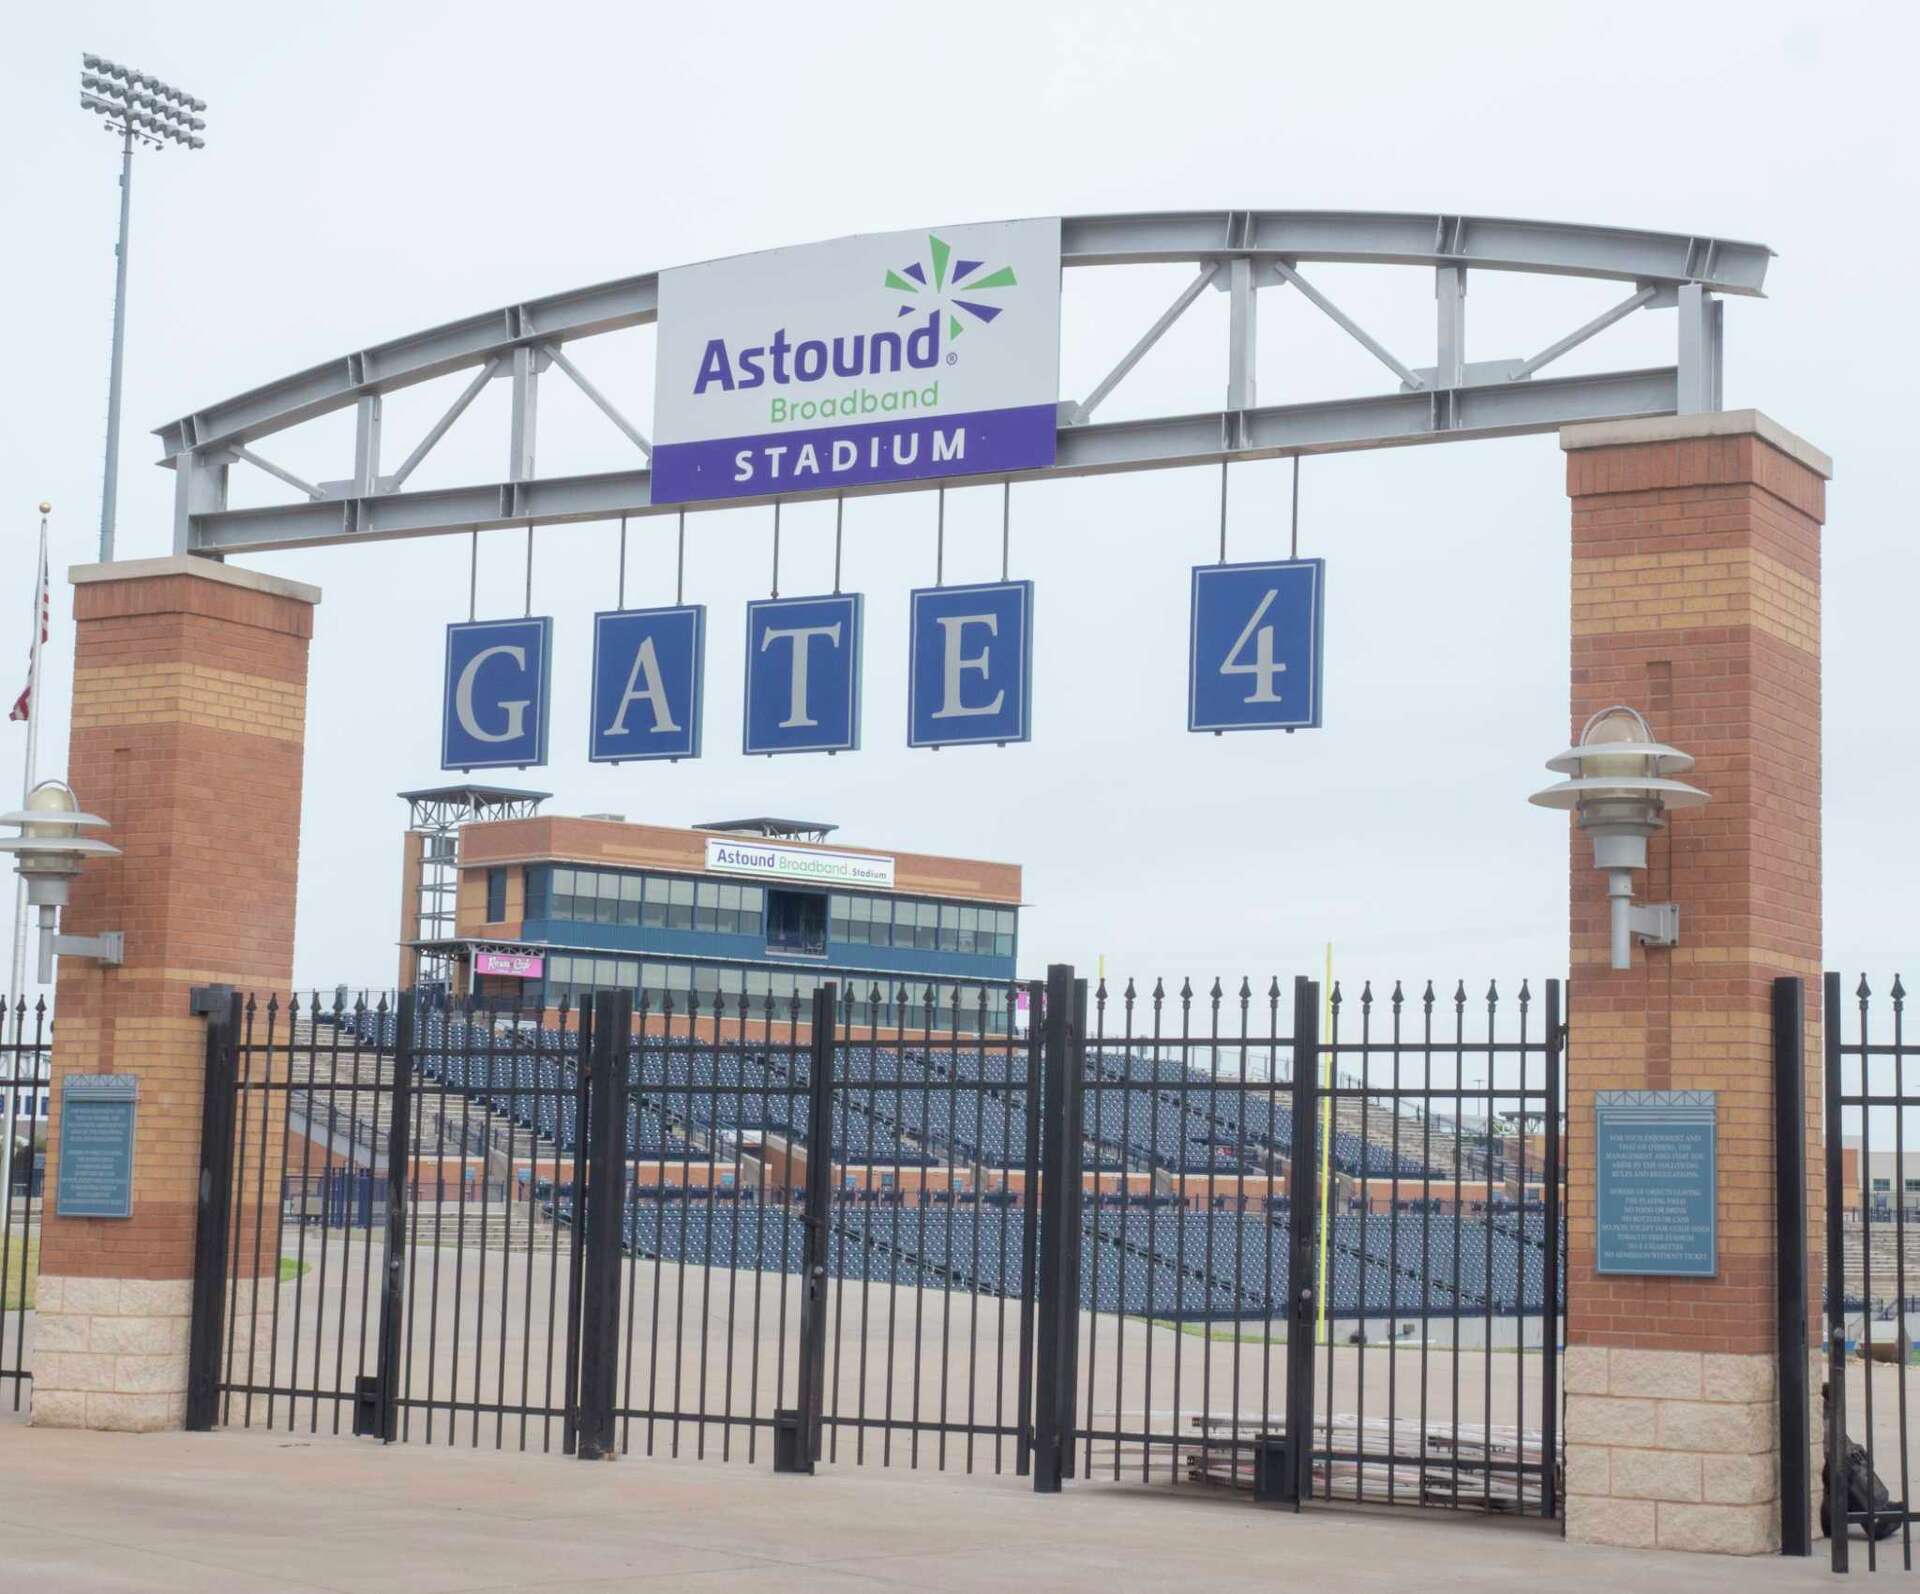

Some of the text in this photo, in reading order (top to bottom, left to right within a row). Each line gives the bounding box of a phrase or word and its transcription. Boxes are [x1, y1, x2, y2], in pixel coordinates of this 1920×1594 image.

[693, 309, 940, 395] Astound
[770, 381, 939, 423] Broadband
[734, 427, 966, 482] STADIUM
[1219, 588, 1287, 704] 4
[717, 848, 888, 880] Astound Broadband Stadium
